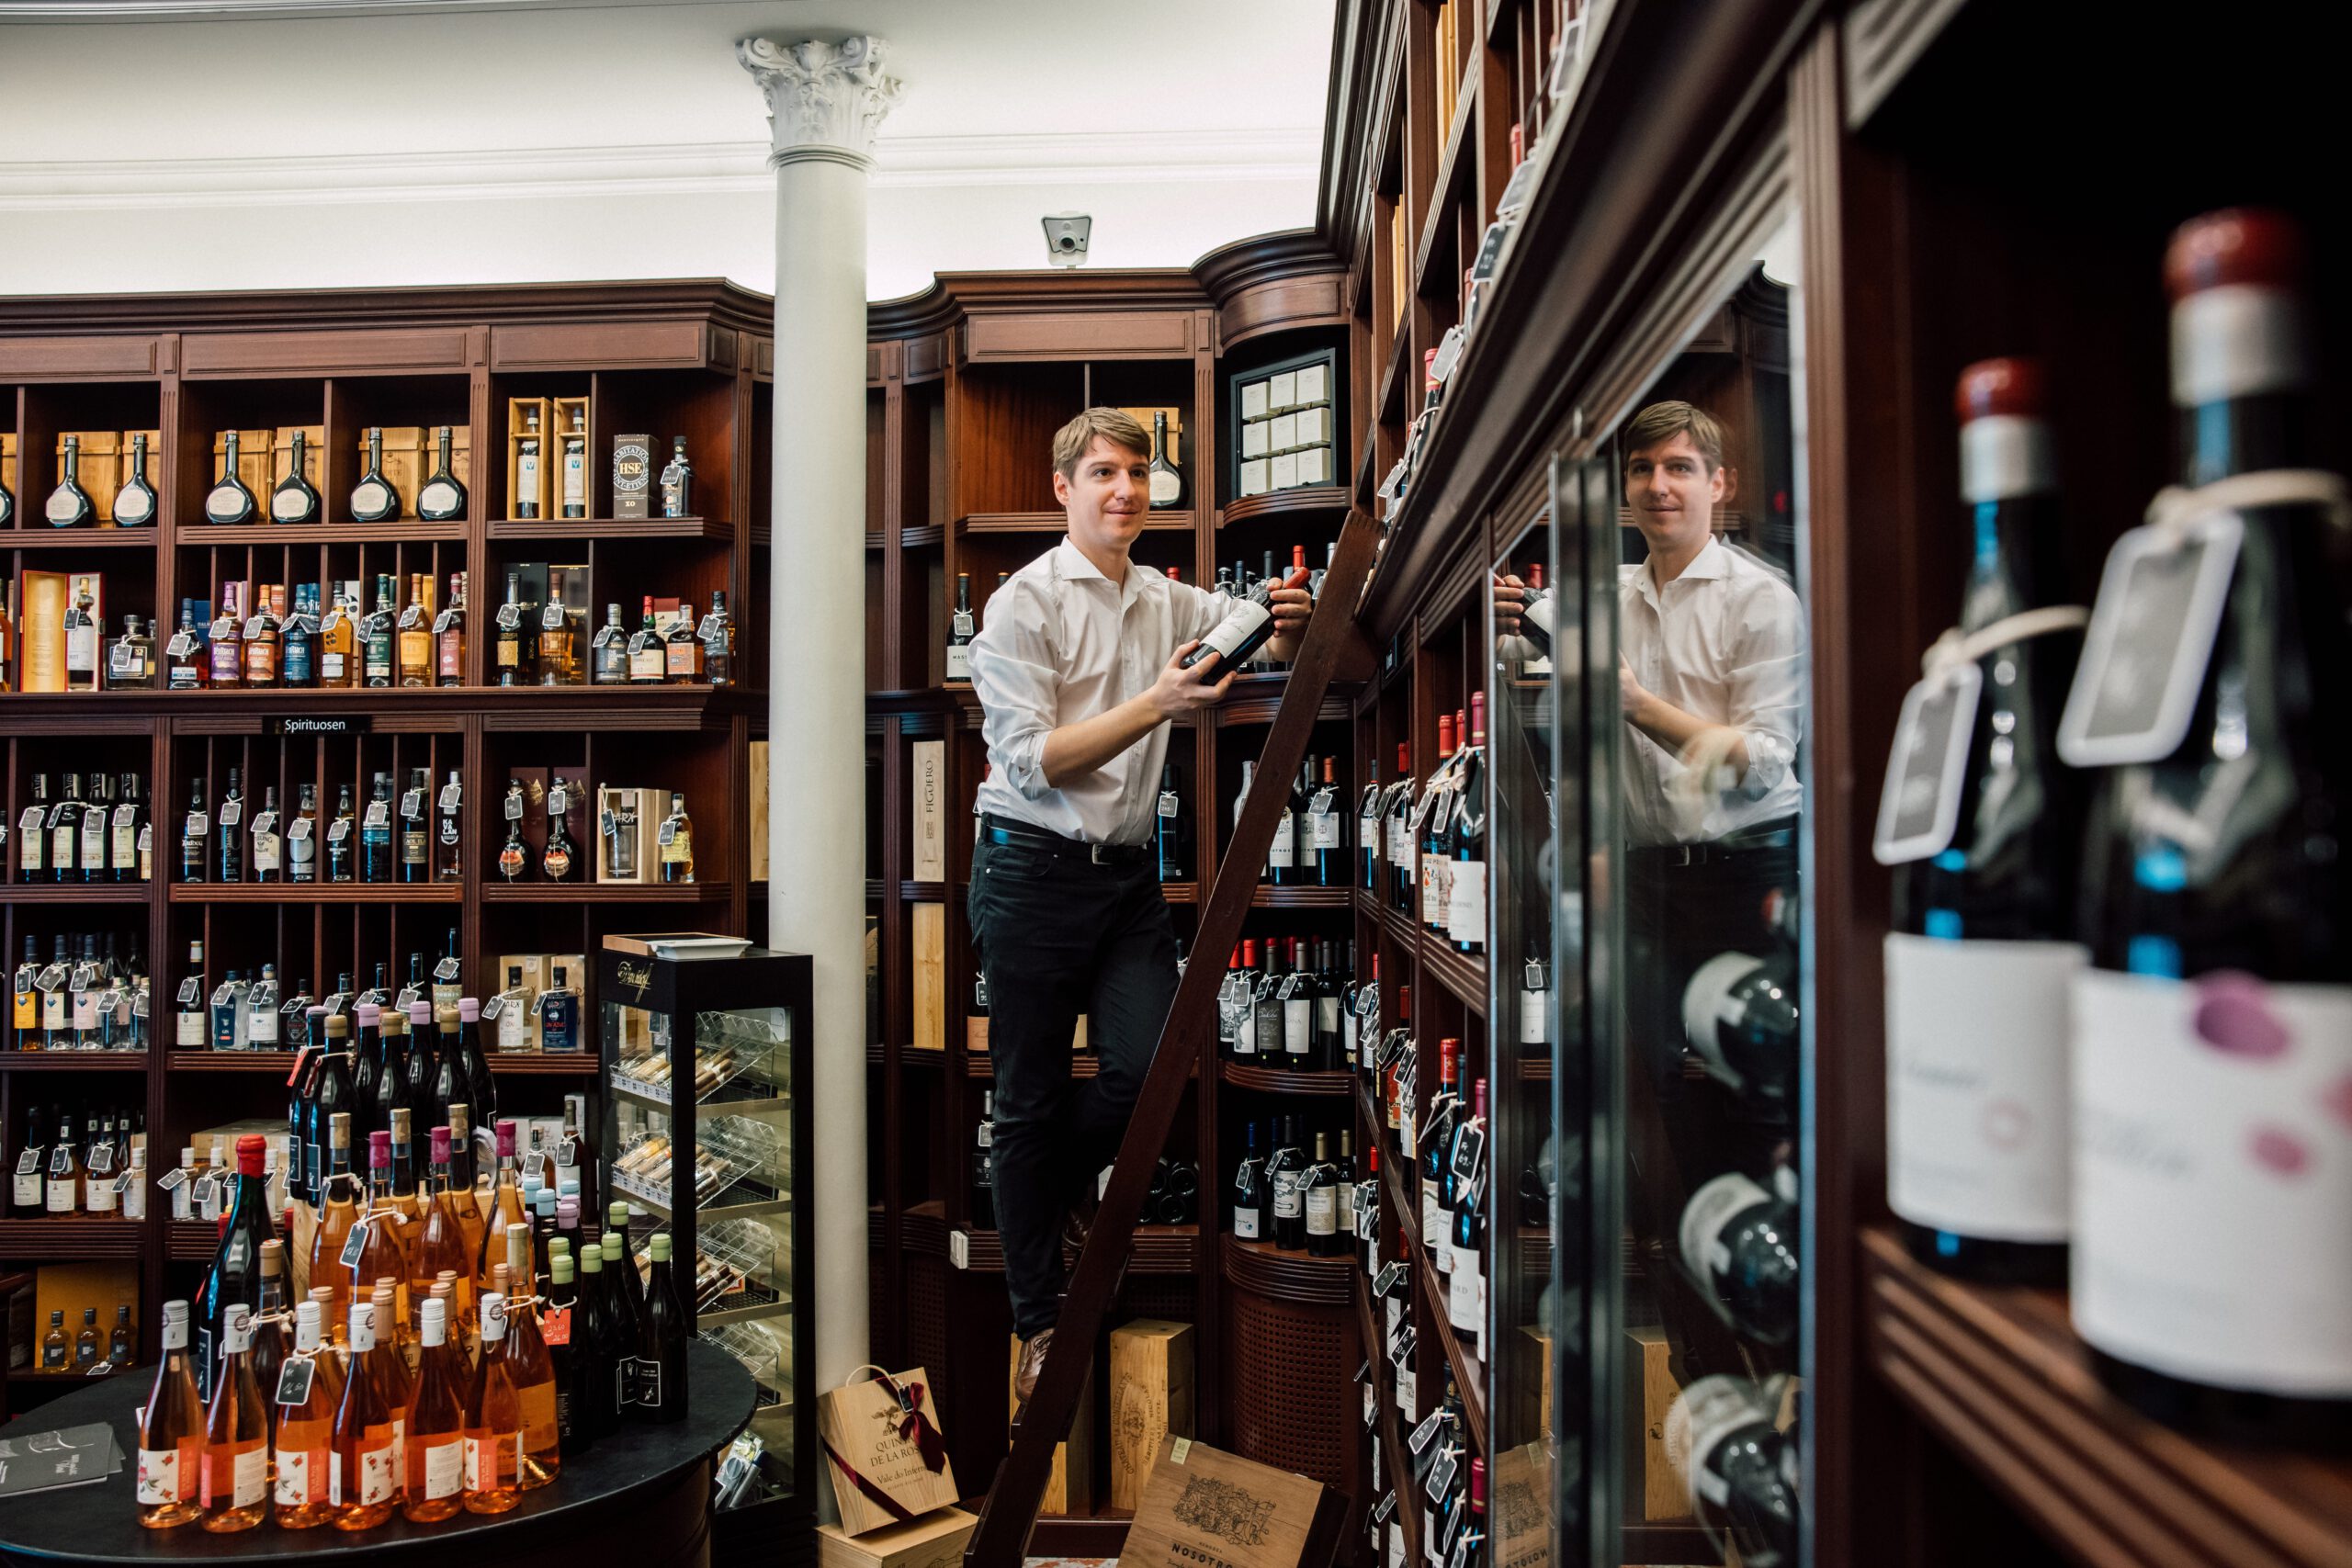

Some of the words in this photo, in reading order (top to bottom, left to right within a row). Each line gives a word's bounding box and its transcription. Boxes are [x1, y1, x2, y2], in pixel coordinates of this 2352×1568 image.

[619, 462, 642, 475] HSE
[285, 719, 345, 733] Spirituosen
[924, 760, 934, 813] FIGUERO
[869, 1454, 884, 1468] DE
[887, 1450, 899, 1463] LA
[901, 1446, 920, 1459] ROS
[876, 1472, 893, 1485] Vale
[894, 1469, 905, 1481] do
[904, 1464, 926, 1478] Infern
[1171, 1543, 1233, 1568] NOSOTRO
